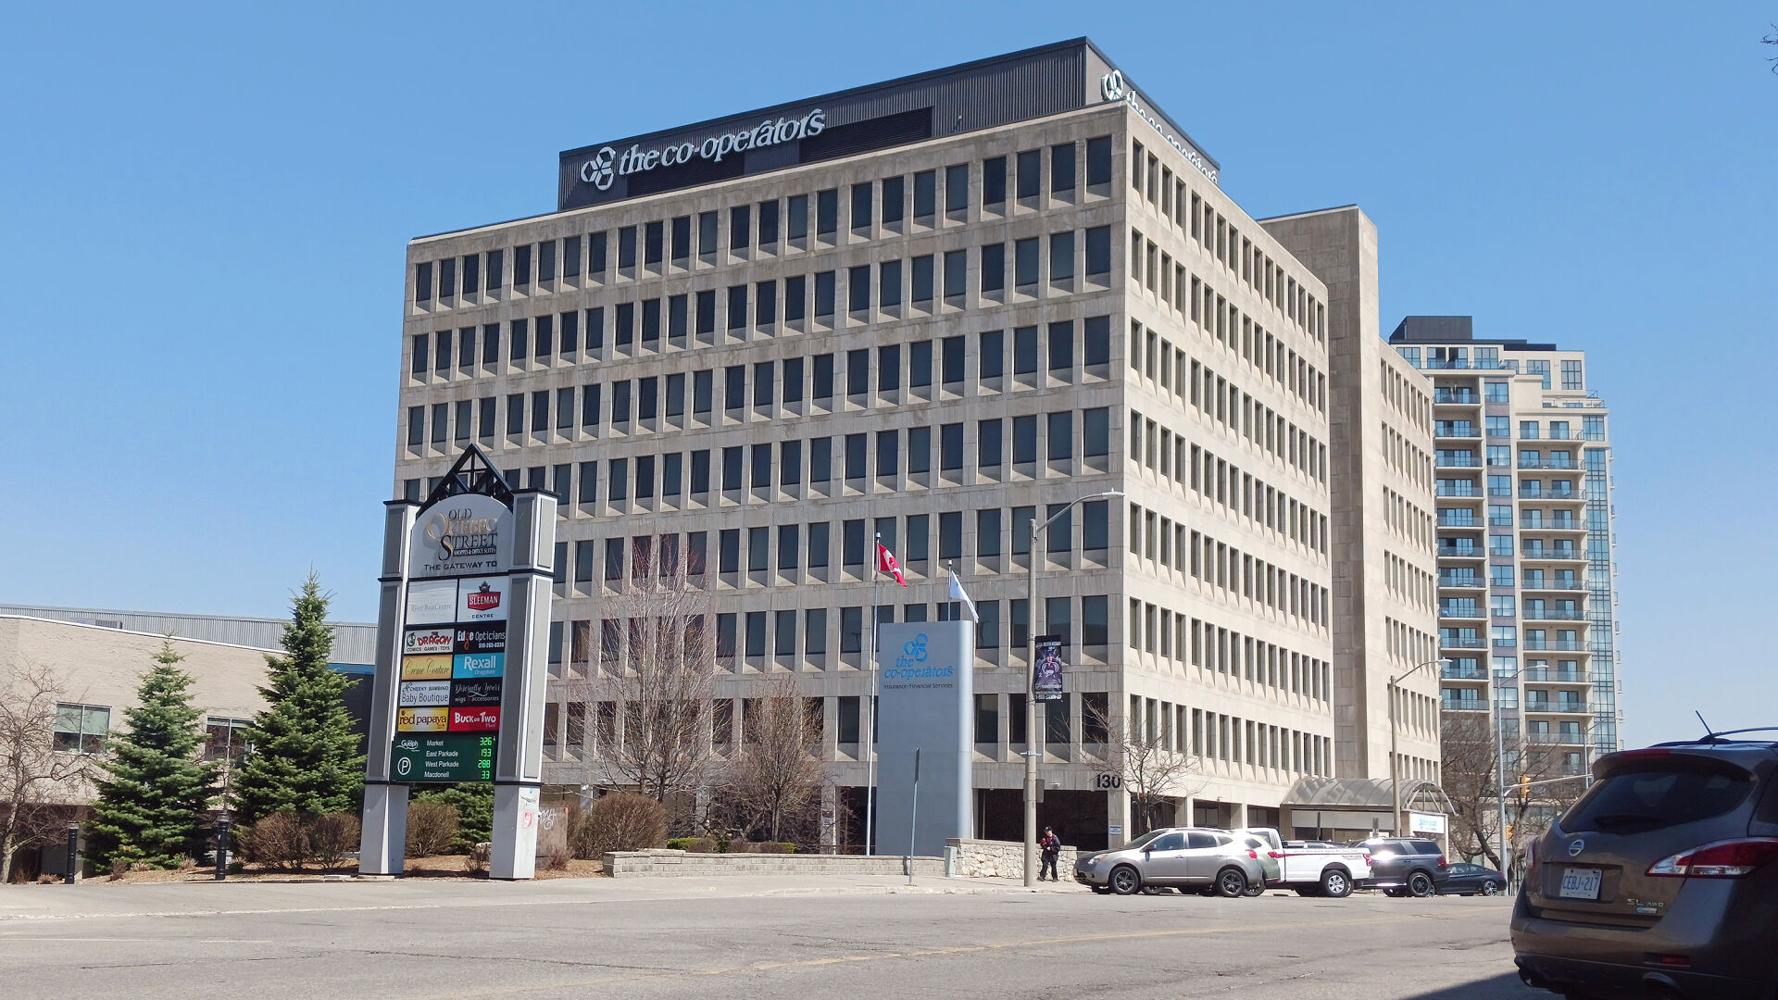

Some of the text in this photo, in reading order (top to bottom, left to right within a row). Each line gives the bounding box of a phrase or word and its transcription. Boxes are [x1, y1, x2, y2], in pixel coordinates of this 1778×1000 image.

[619, 144, 660, 176] the
[448, 508, 472, 520] OLD
[438, 532, 498, 560] STREET
[444, 562, 483, 570] GATEWAY
[468, 596, 498, 606] SLEEMAN
[417, 634, 452, 646] DRAGON
[475, 631, 506, 642] Opticians
[464, 656, 496, 670] Rexall
[402, 692, 448, 704] Baby Boutique
[400, 714, 447, 725] red papaya
[480, 737, 492, 746] 326
[481, 771, 490, 780] 33
[1097, 774, 1120, 788] 130
